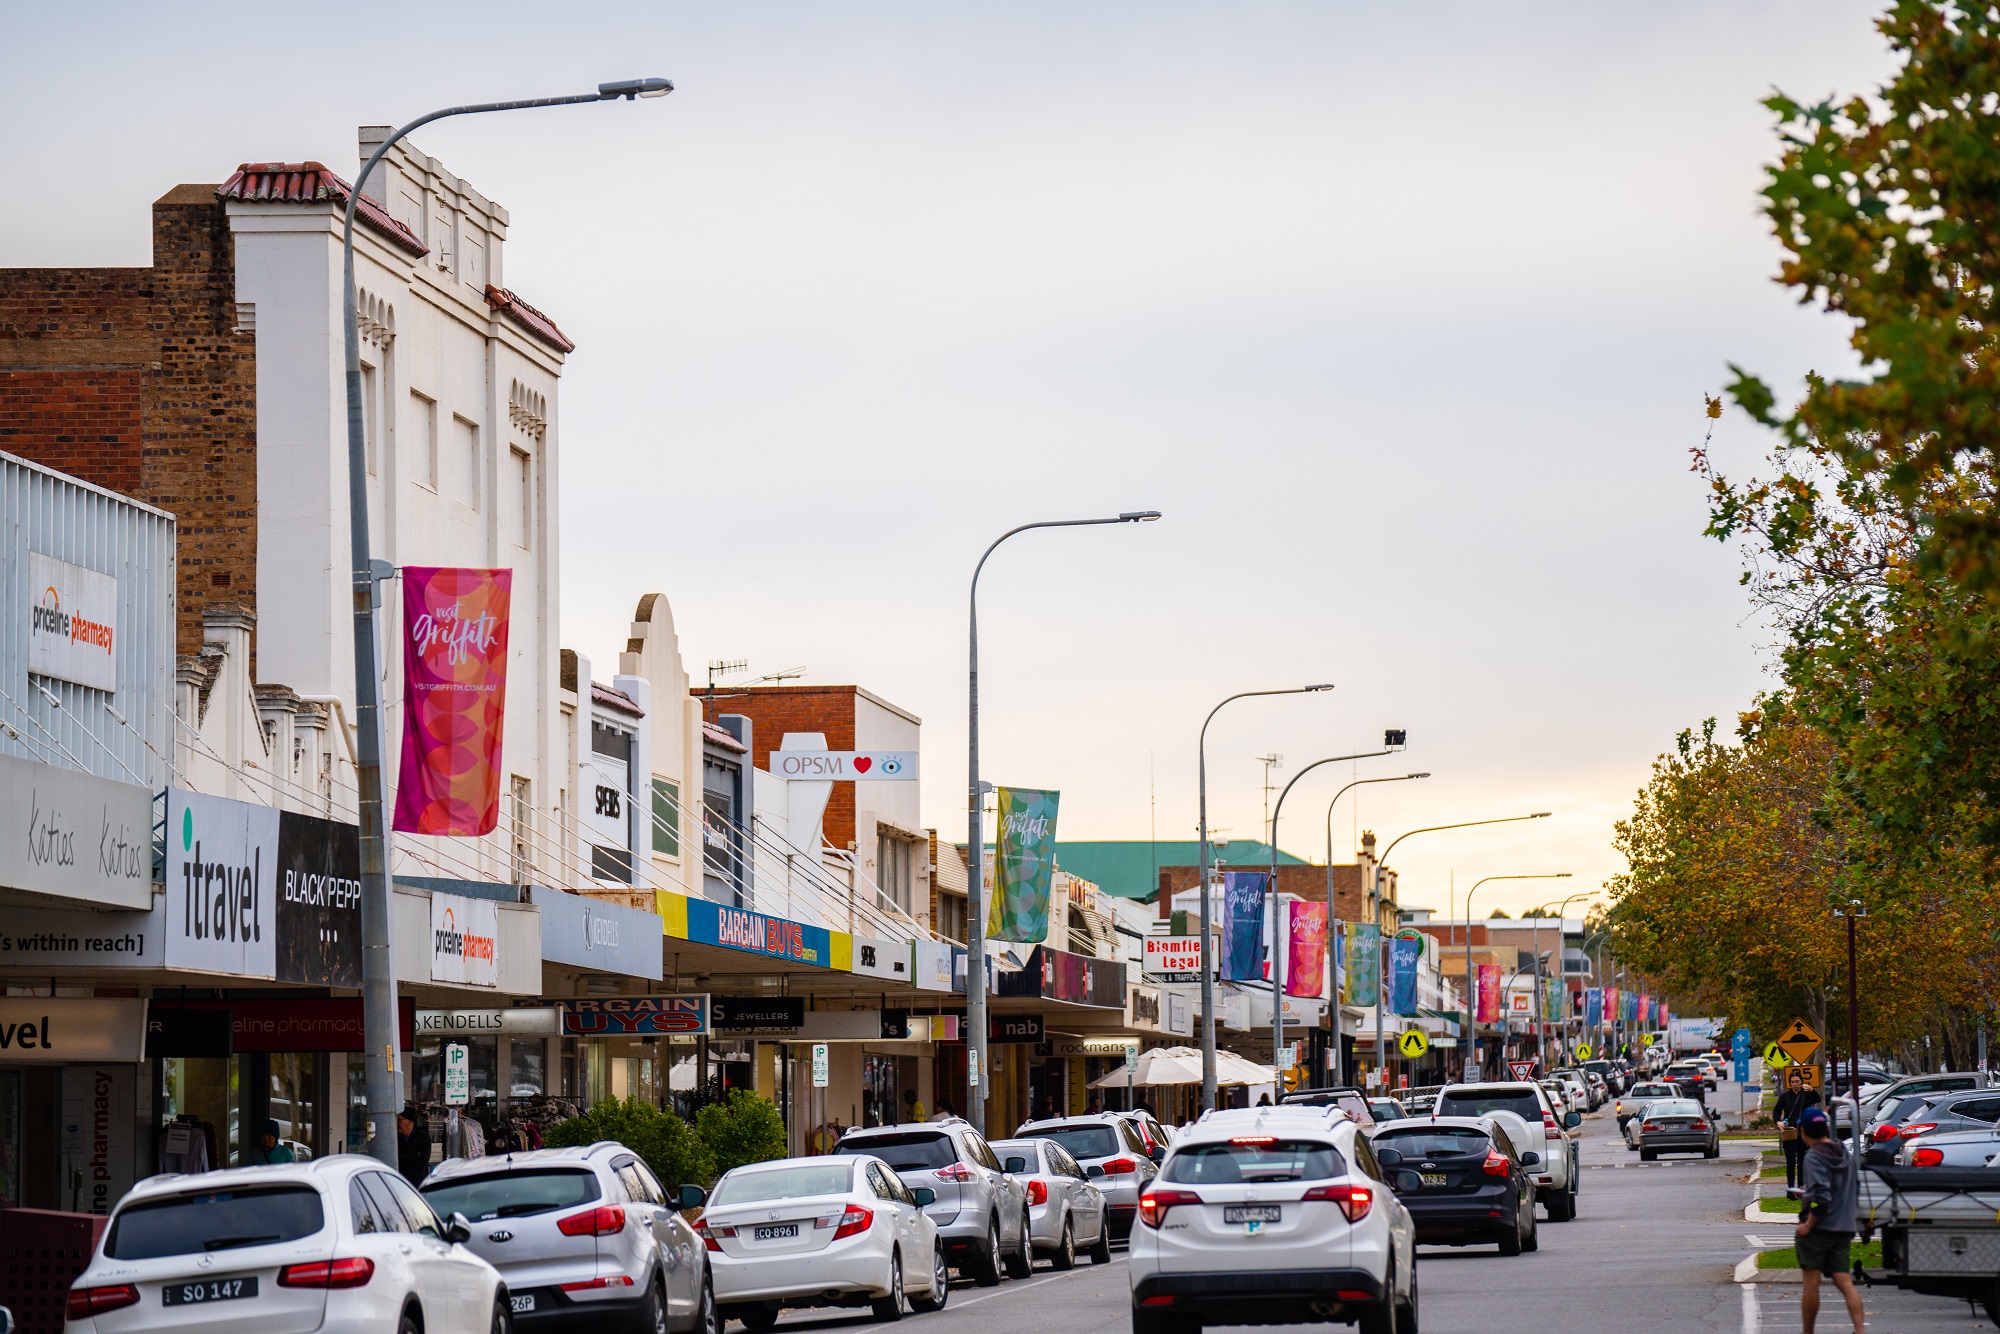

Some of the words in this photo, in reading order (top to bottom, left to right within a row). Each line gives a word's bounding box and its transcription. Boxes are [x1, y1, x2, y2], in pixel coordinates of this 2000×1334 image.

[436, 601, 464, 623] visit
[33, 600, 69, 637] priceline
[71, 609, 113, 655] pharmacy
[414, 682, 496, 692] VISITGRIFFITH.COM.AU
[782, 756, 843, 775] OPSM
[27, 787, 74, 867] Katies
[98, 802, 141, 878] Katies
[183, 806, 260, 943] itravel
[286, 869, 325, 907] BLACK
[328, 876, 361, 910] PEPP
[719, 907, 765, 951] BARGAIN
[766, 918, 804, 959] BUYS
[17, 933, 79, 951] within
[84, 934, 144, 956] reach]
[435, 929, 462, 963] priceline
[463, 929, 494, 966] pharmacy
[1147, 940, 1214, 953] Blomfie
[1163, 955, 1199, 970] Legal
[530, 998, 700, 1014] ARGAIN
[277, 1016, 365, 1036] pharmacy
[423, 1014, 503, 1029] KENDELLS
[566, 1012, 703, 1032] UYS
[734, 1012, 789, 1021] JEWELLERS
[1005, 1019, 1039, 1035] nab
[450, 1048, 464, 1064] 1P
[815, 1047, 825, 1058] 1P
[1061, 1041, 1125, 1053] rockmans
[89, 1071, 113, 1181] pharmacy
[492, 1231, 510, 1241] KIA
[1248, 1222, 1260, 1232] P
[210, 1280, 243, 1299] 147
